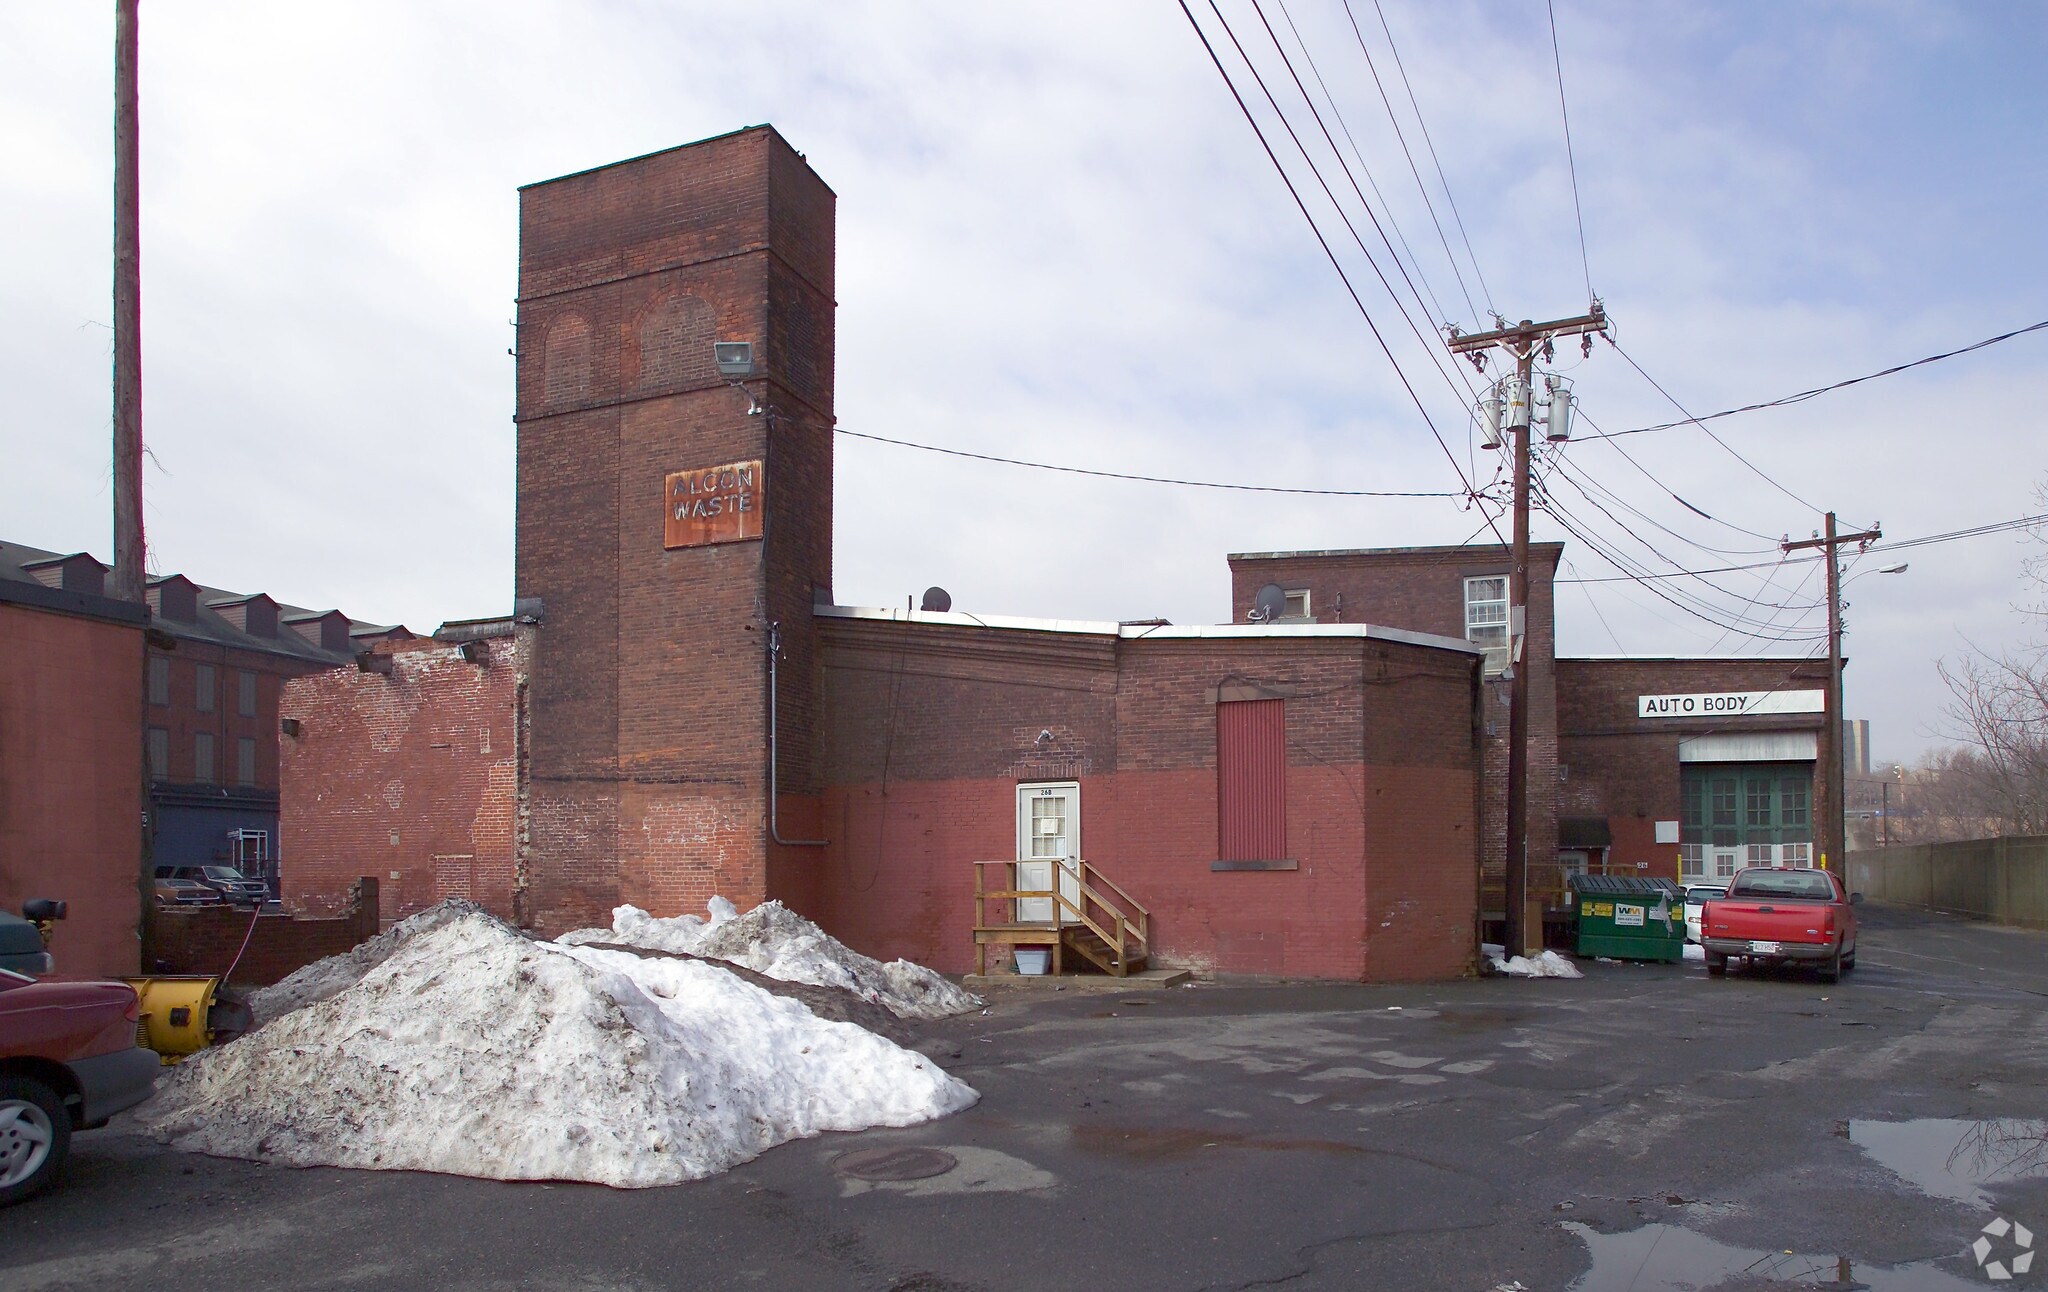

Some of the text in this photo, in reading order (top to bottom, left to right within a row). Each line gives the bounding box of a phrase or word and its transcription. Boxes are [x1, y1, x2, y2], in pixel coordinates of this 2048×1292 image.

[673, 467, 753, 496] ALCON
[673, 491, 753, 520] WASTE
[1646, 696, 1748, 712] AUTO BODY
[1618, 907, 1641, 915] WM
